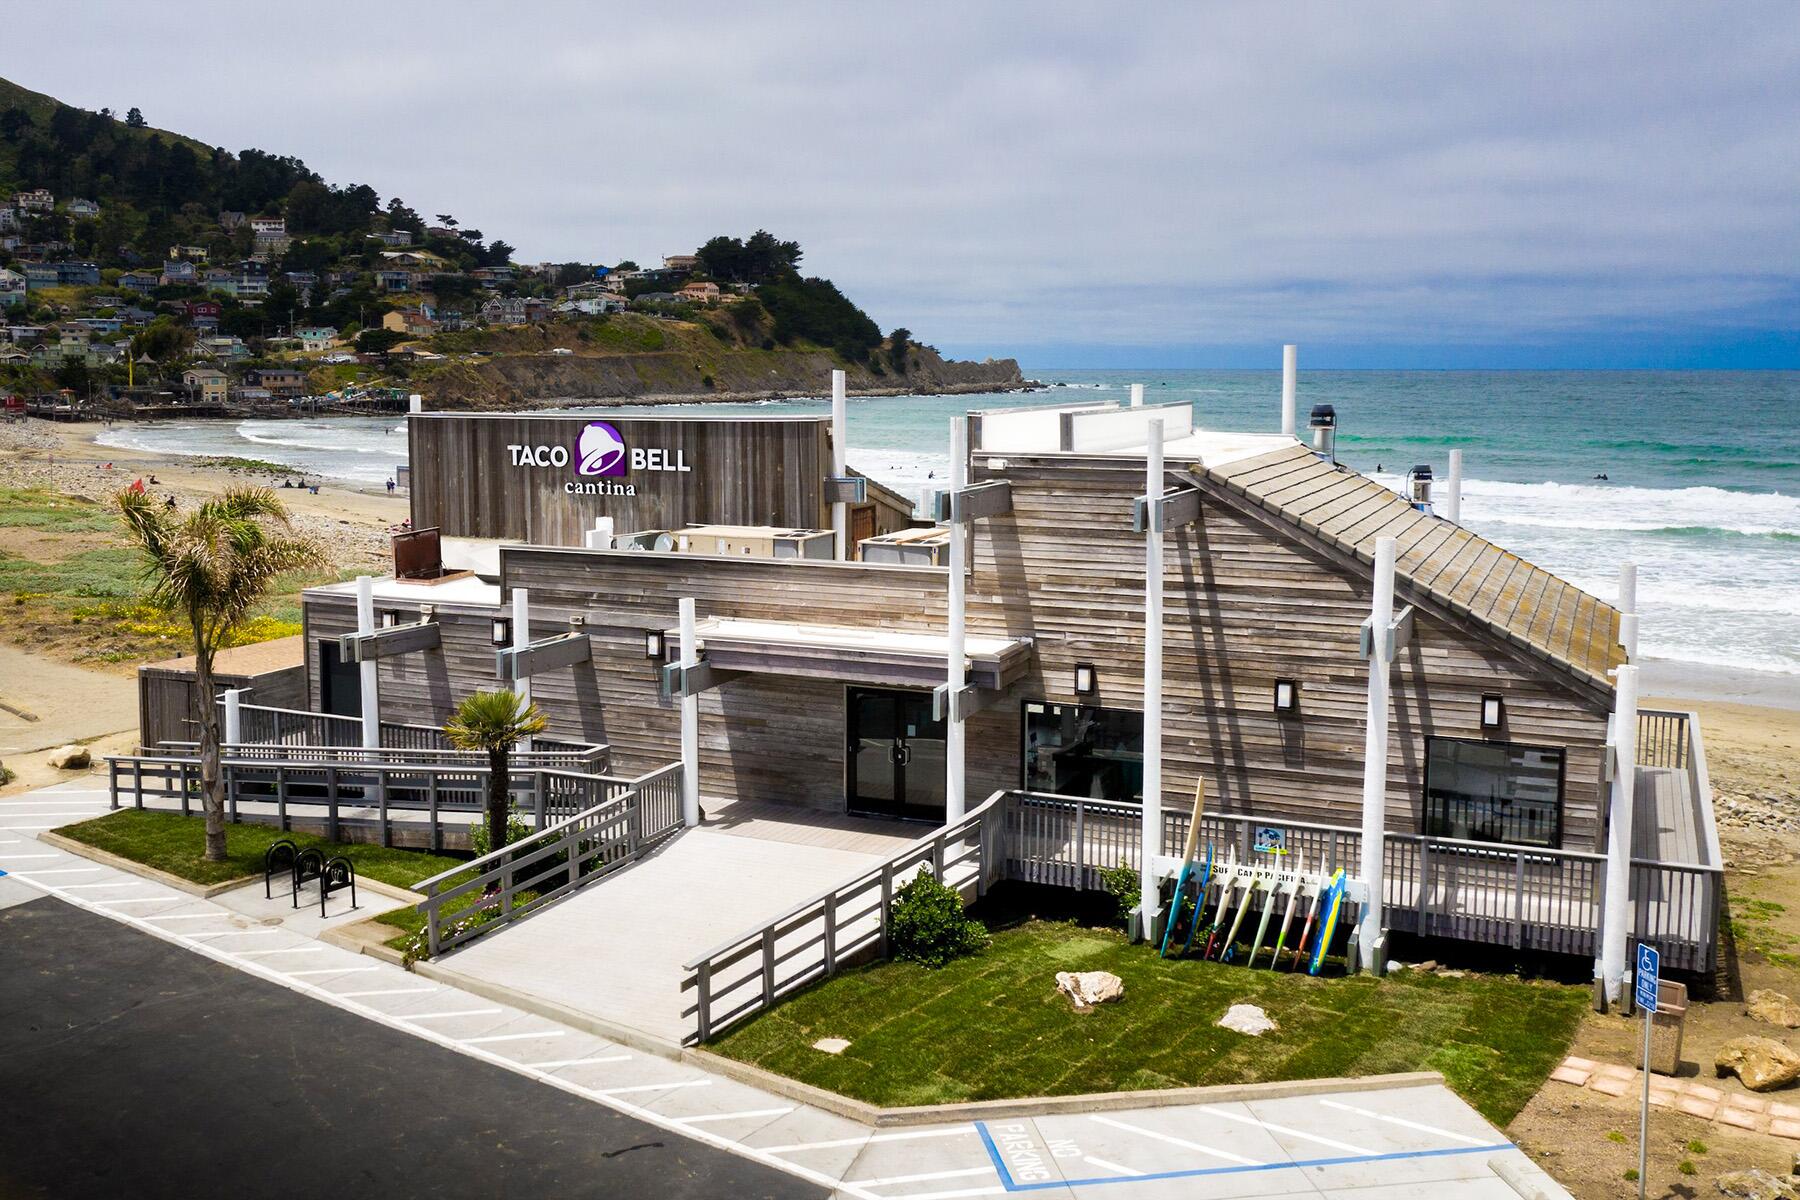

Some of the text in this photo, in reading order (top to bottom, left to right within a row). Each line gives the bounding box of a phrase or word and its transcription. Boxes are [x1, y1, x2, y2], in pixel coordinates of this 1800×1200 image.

[506, 444, 692, 472] TACO BELL
[564, 480, 637, 497] cantina
[993, 1123, 1052, 1181] PARKING
[1047, 1139, 1083, 1158] NO
